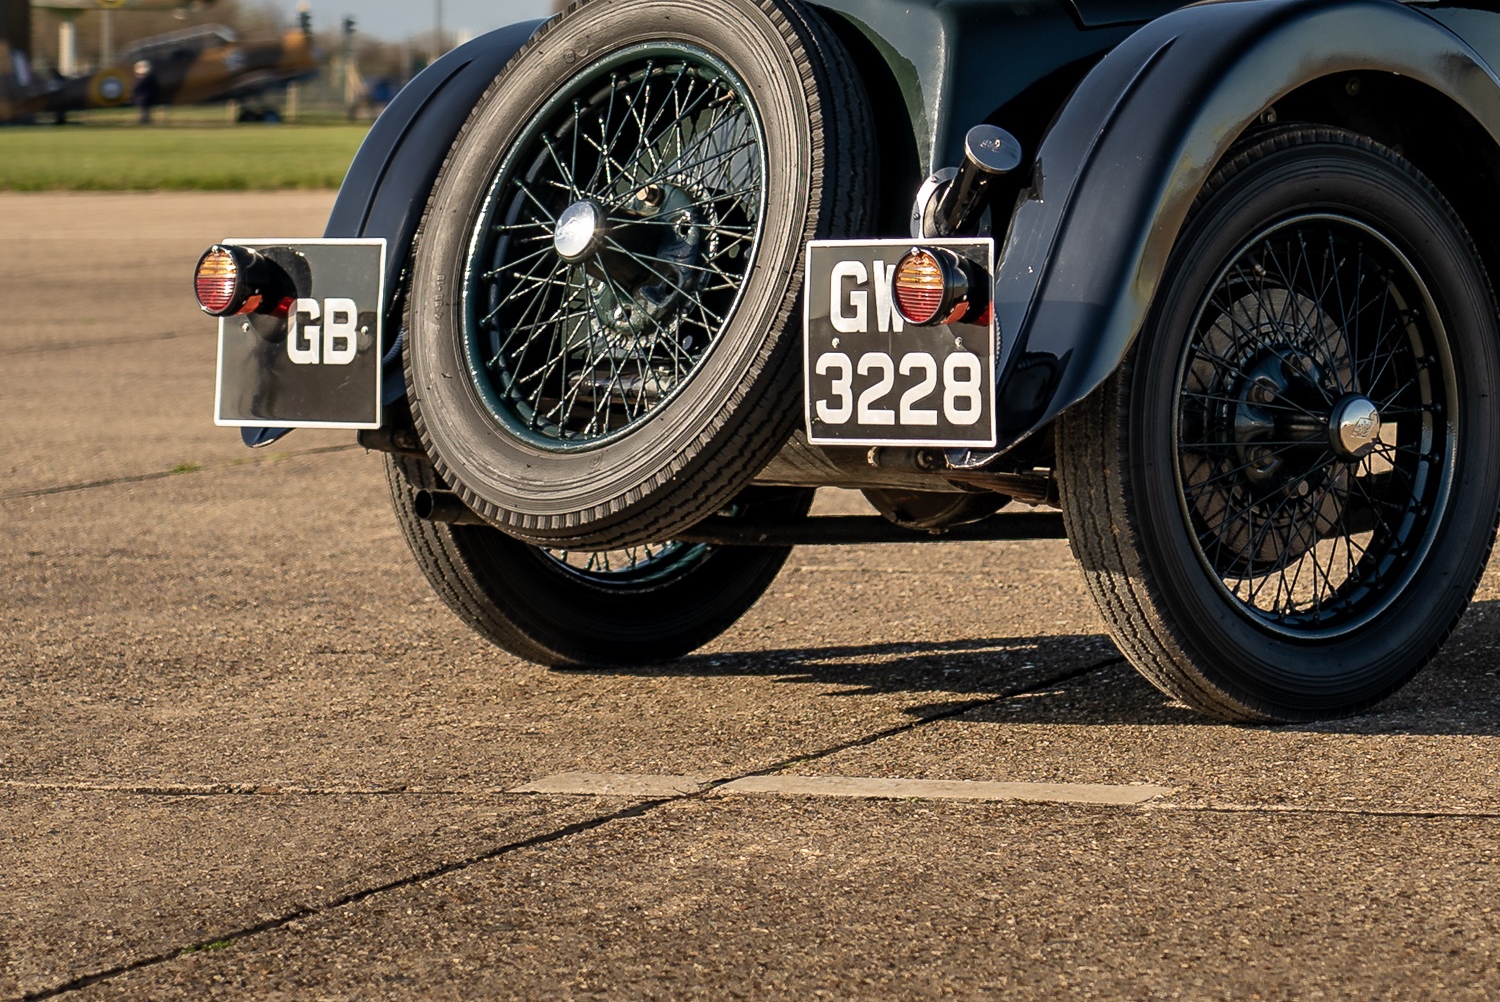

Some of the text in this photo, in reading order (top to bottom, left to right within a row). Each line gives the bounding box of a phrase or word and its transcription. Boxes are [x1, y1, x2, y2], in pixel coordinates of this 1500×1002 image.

[287, 298, 358, 365] GB
[830, 260, 905, 333] GW
[815, 352, 982, 425] 3228
